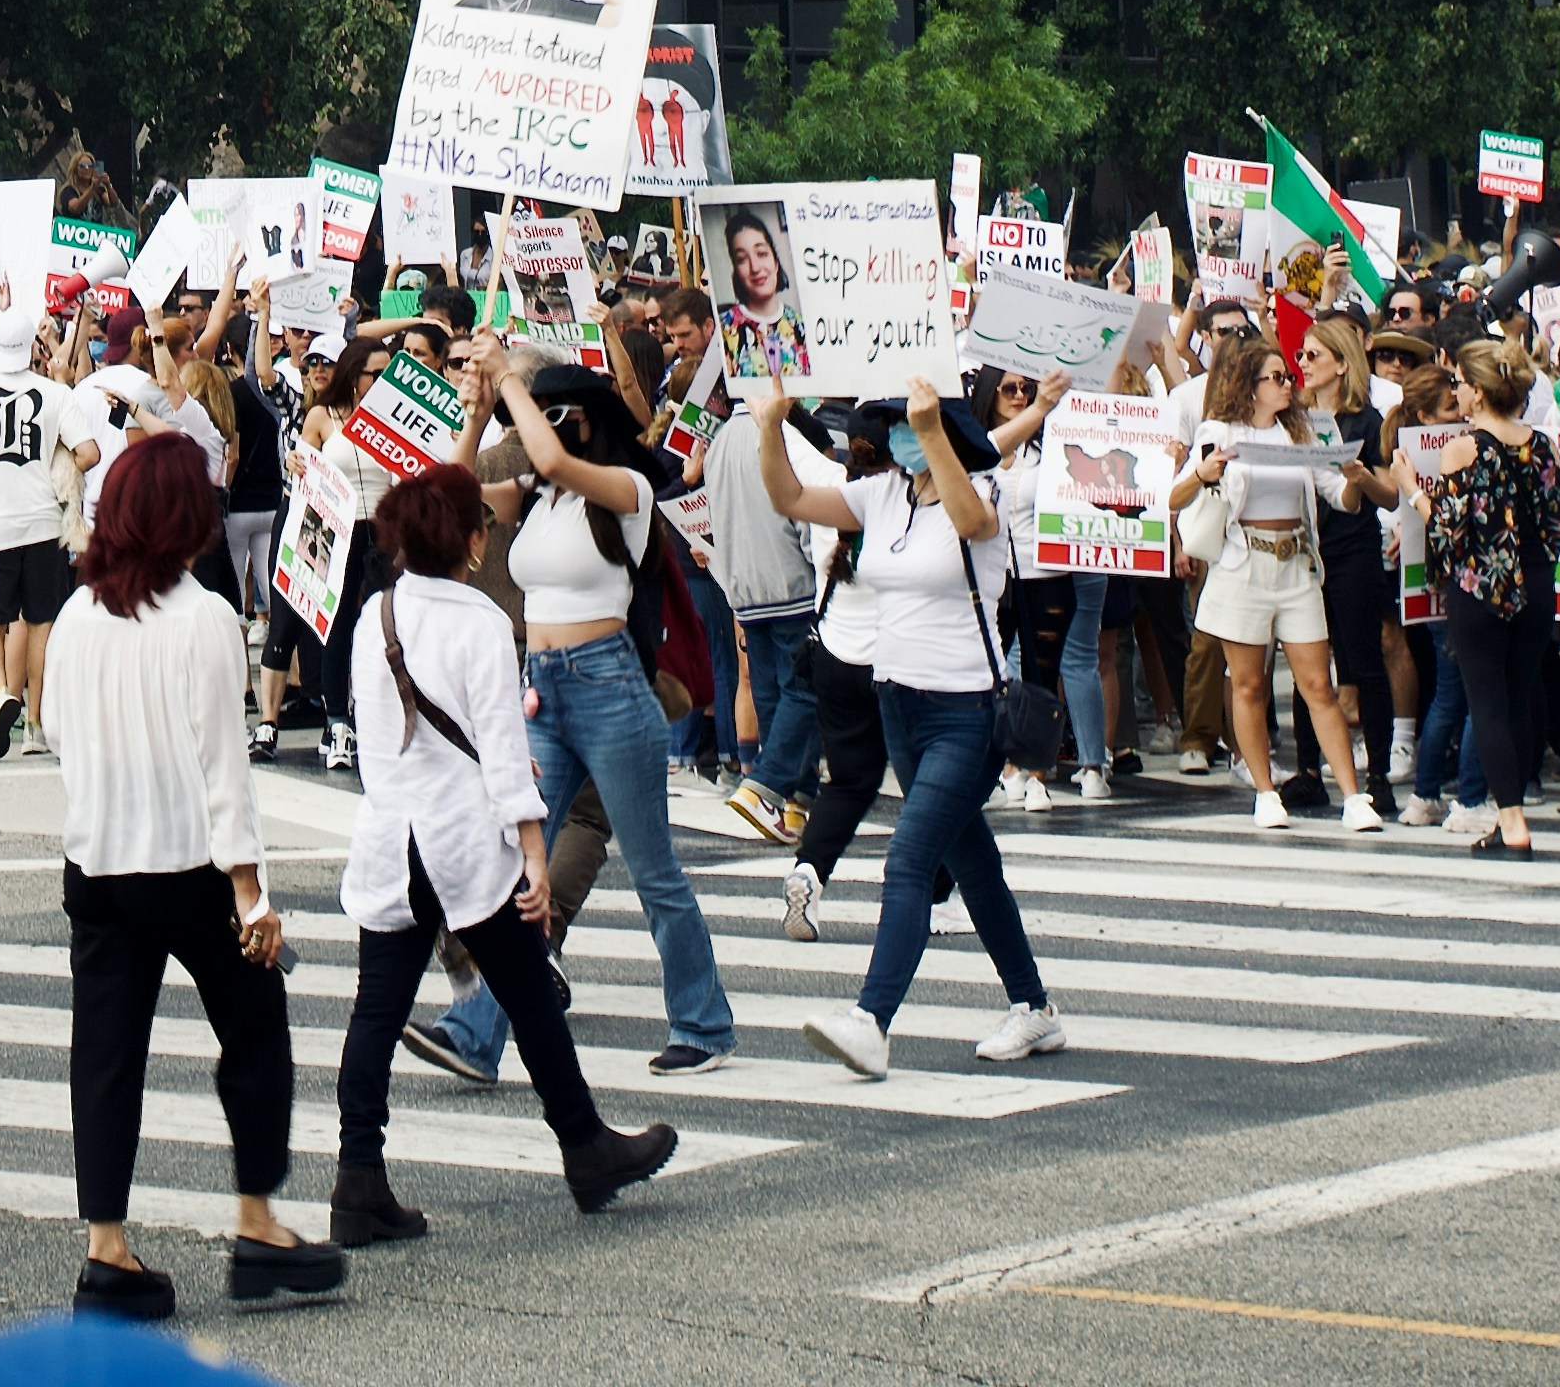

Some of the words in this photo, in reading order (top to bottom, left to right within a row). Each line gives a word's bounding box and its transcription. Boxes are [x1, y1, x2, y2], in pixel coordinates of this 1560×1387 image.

[475, 66, 612, 114] MURDERED
[410, 96, 442, 139] by
[452, 99, 500, 138] the
[510, 106, 591, 150] IRGC
[1484, 133, 1540, 156] WOMEN
[1196, 160, 1240, 183] IRAN
[1497, 158, 1526, 173] LIFE
[314, 164, 378, 199] WOMEN
[1482, 177, 1538, 196] FREEDOM
[1193, 184, 1245, 209] STAND
[524, 226, 564, 239] Silence
[991, 223, 1021, 245] NO
[1026, 226, 1046, 247] TO
[315, 265, 350, 277] reedom.
[517, 255, 584, 274] Oppressor
[803, 248, 859, 300] Stop
[866, 244, 938, 301] killing
[980, 250, 1062, 274] ISLAMIC
[528, 321, 585, 343] STAND
[815, 316, 851, 348] our
[866, 310, 938, 364] youth
[1071, 398, 1108, 415] Media
[1113, 400, 1159, 419] Silence
[391, 402, 438, 443] LIFE
[1051, 424, 1109, 444] Supporting
[1113, 428, 1173, 446] Oppressor
[1057, 480, 1156, 507] #MahsaAmini
[1416, 472, 1434, 493] he
[1061, 515, 1143, 540] STAND
[1069, 544, 1134, 569] IRAN
[290, 553, 328, 603] STAND
[287, 578, 318, 625] IRAN
